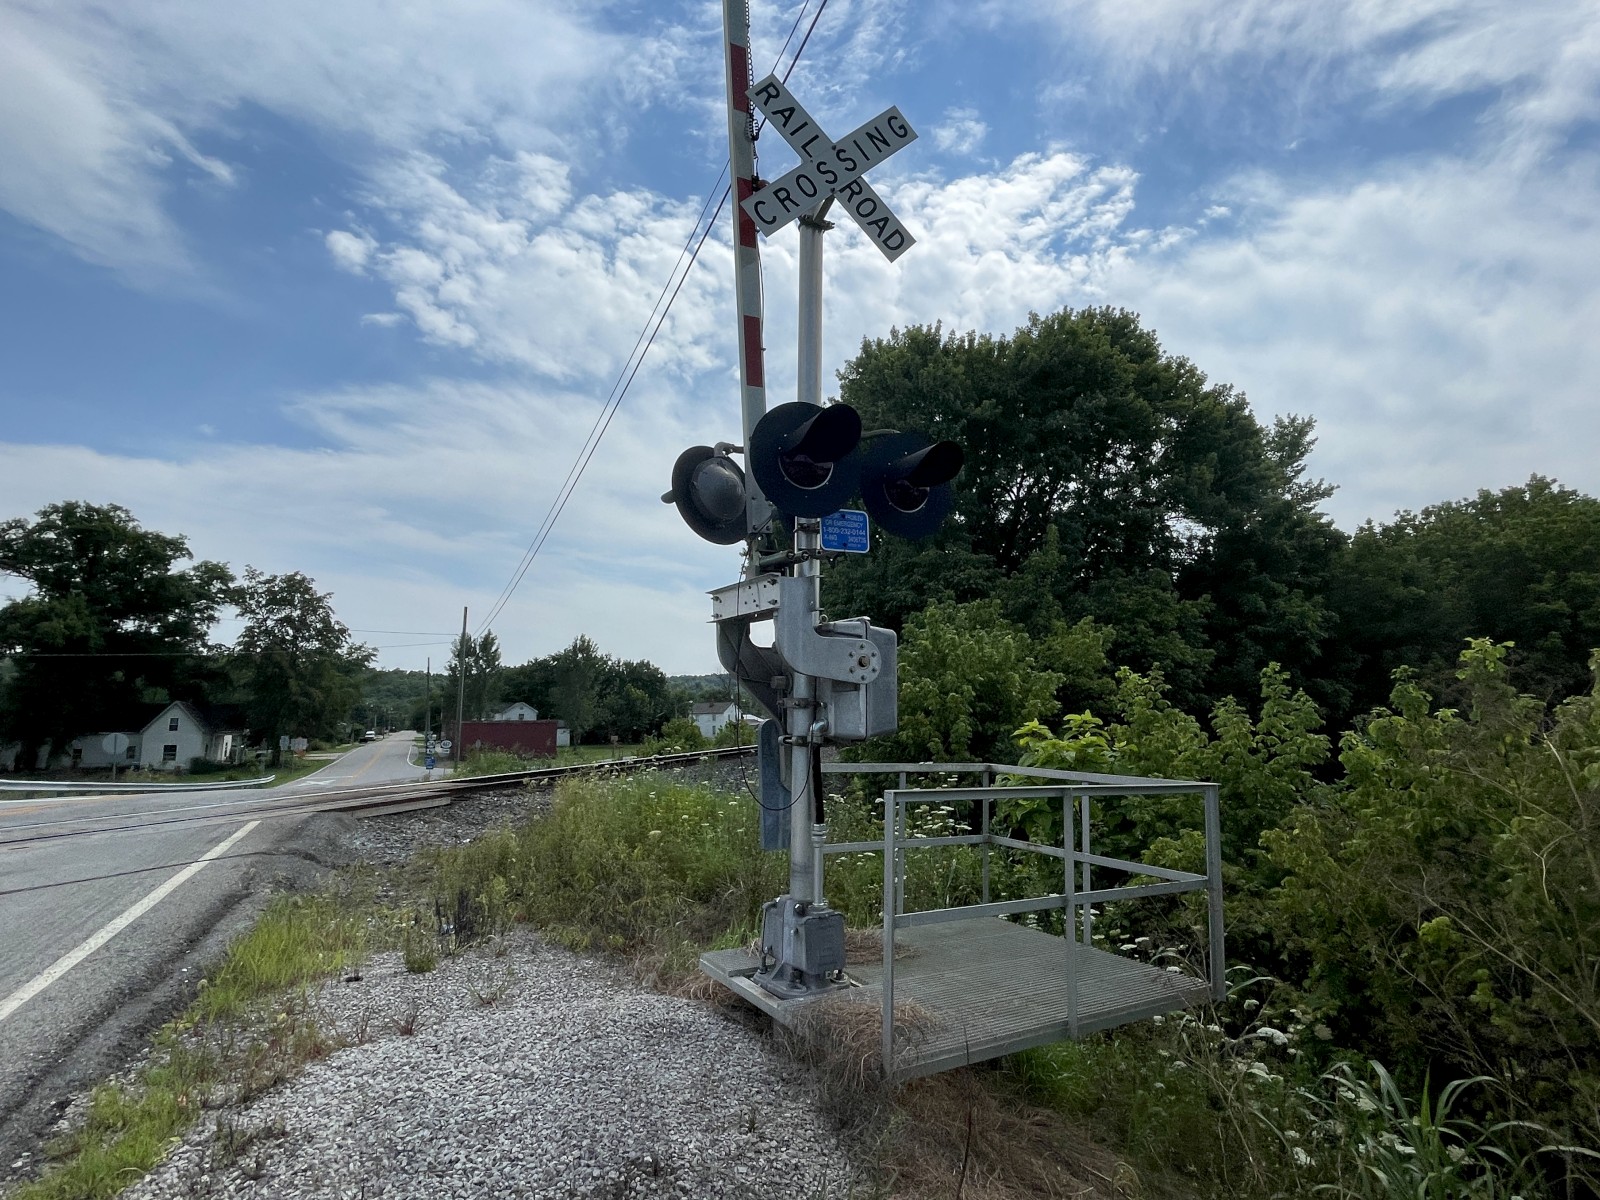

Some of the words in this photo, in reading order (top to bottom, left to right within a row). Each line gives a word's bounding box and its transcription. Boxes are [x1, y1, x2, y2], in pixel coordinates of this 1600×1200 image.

[753, 115, 908, 226] CROSSING
[755, 81, 820, 158] RAIL
[839, 177, 905, 251] ROAD
